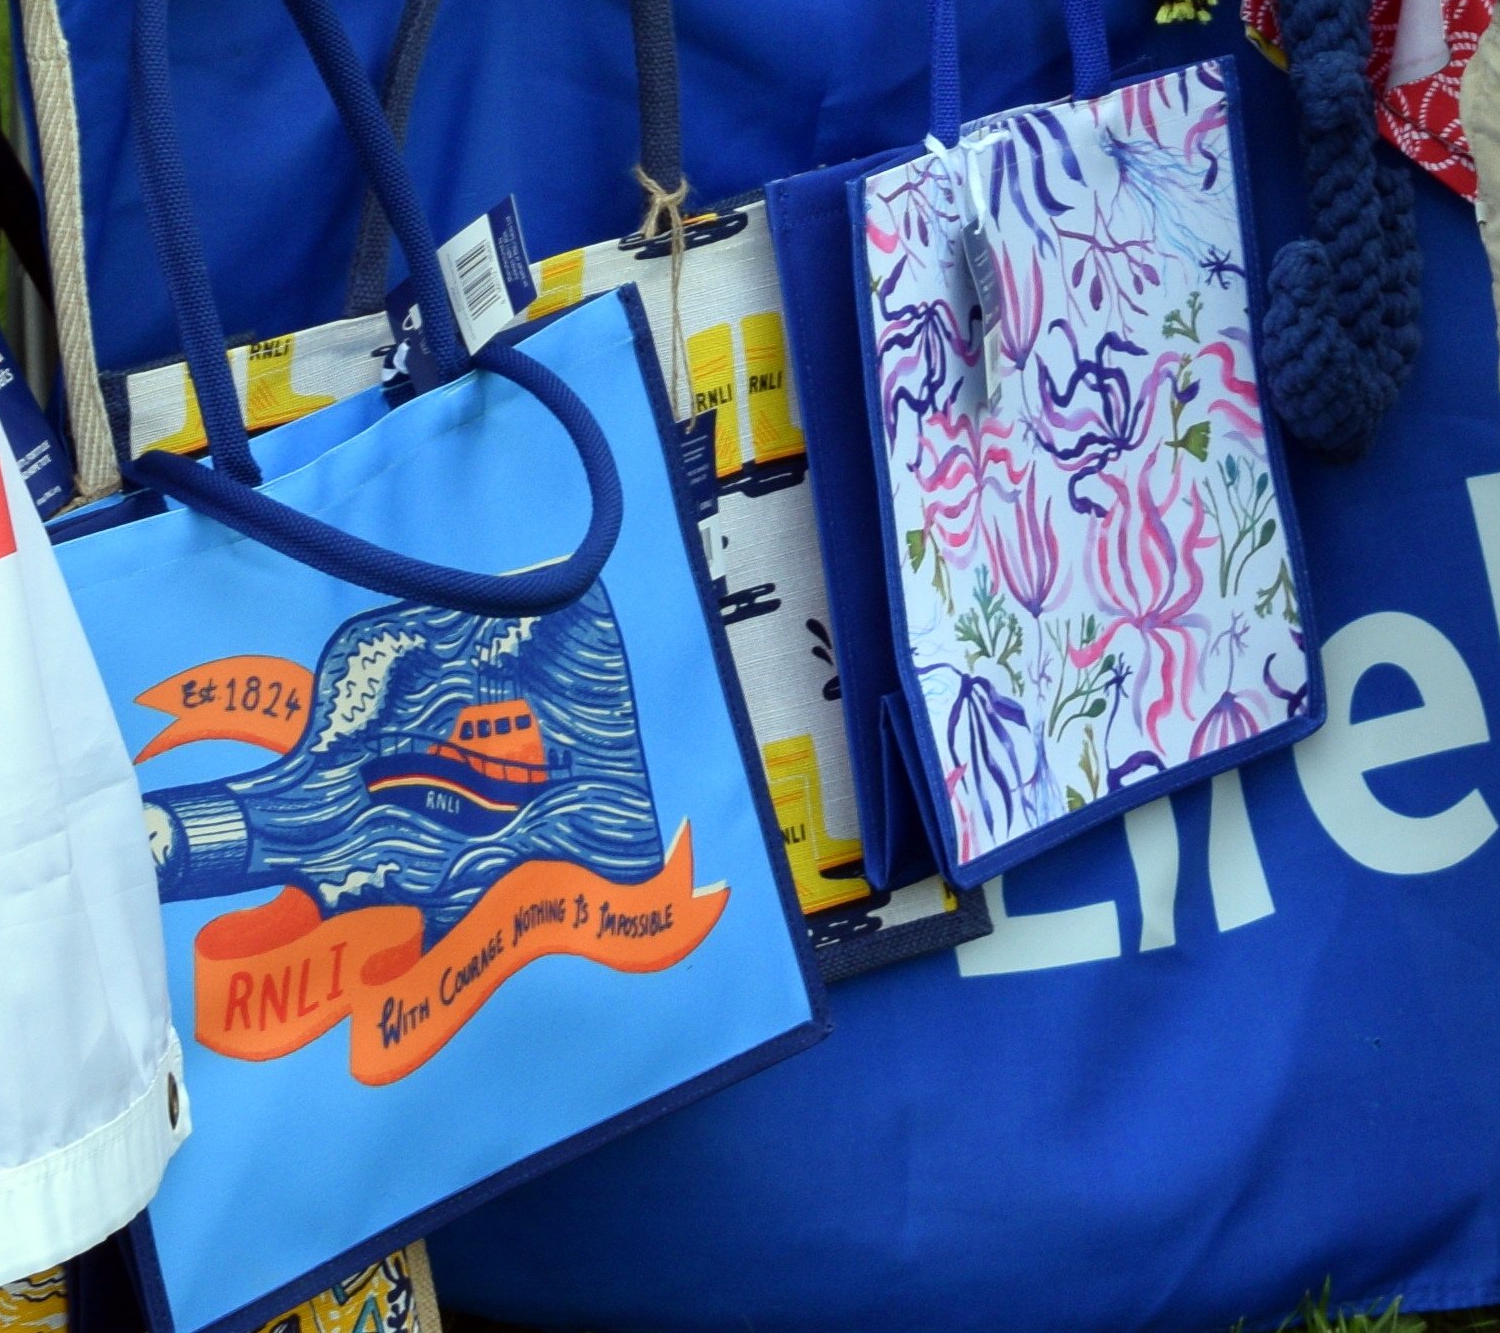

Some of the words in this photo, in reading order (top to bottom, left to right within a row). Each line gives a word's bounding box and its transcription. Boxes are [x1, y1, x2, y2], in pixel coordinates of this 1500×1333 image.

[749, 370, 783, 393] RNLI
[696, 383, 733, 412] RNLI
[225, 675, 302, 721] 1824
[426, 790, 460, 814] RNLI
[780, 822, 806, 844] NLI
[224, 940, 347, 1032] RNLI
